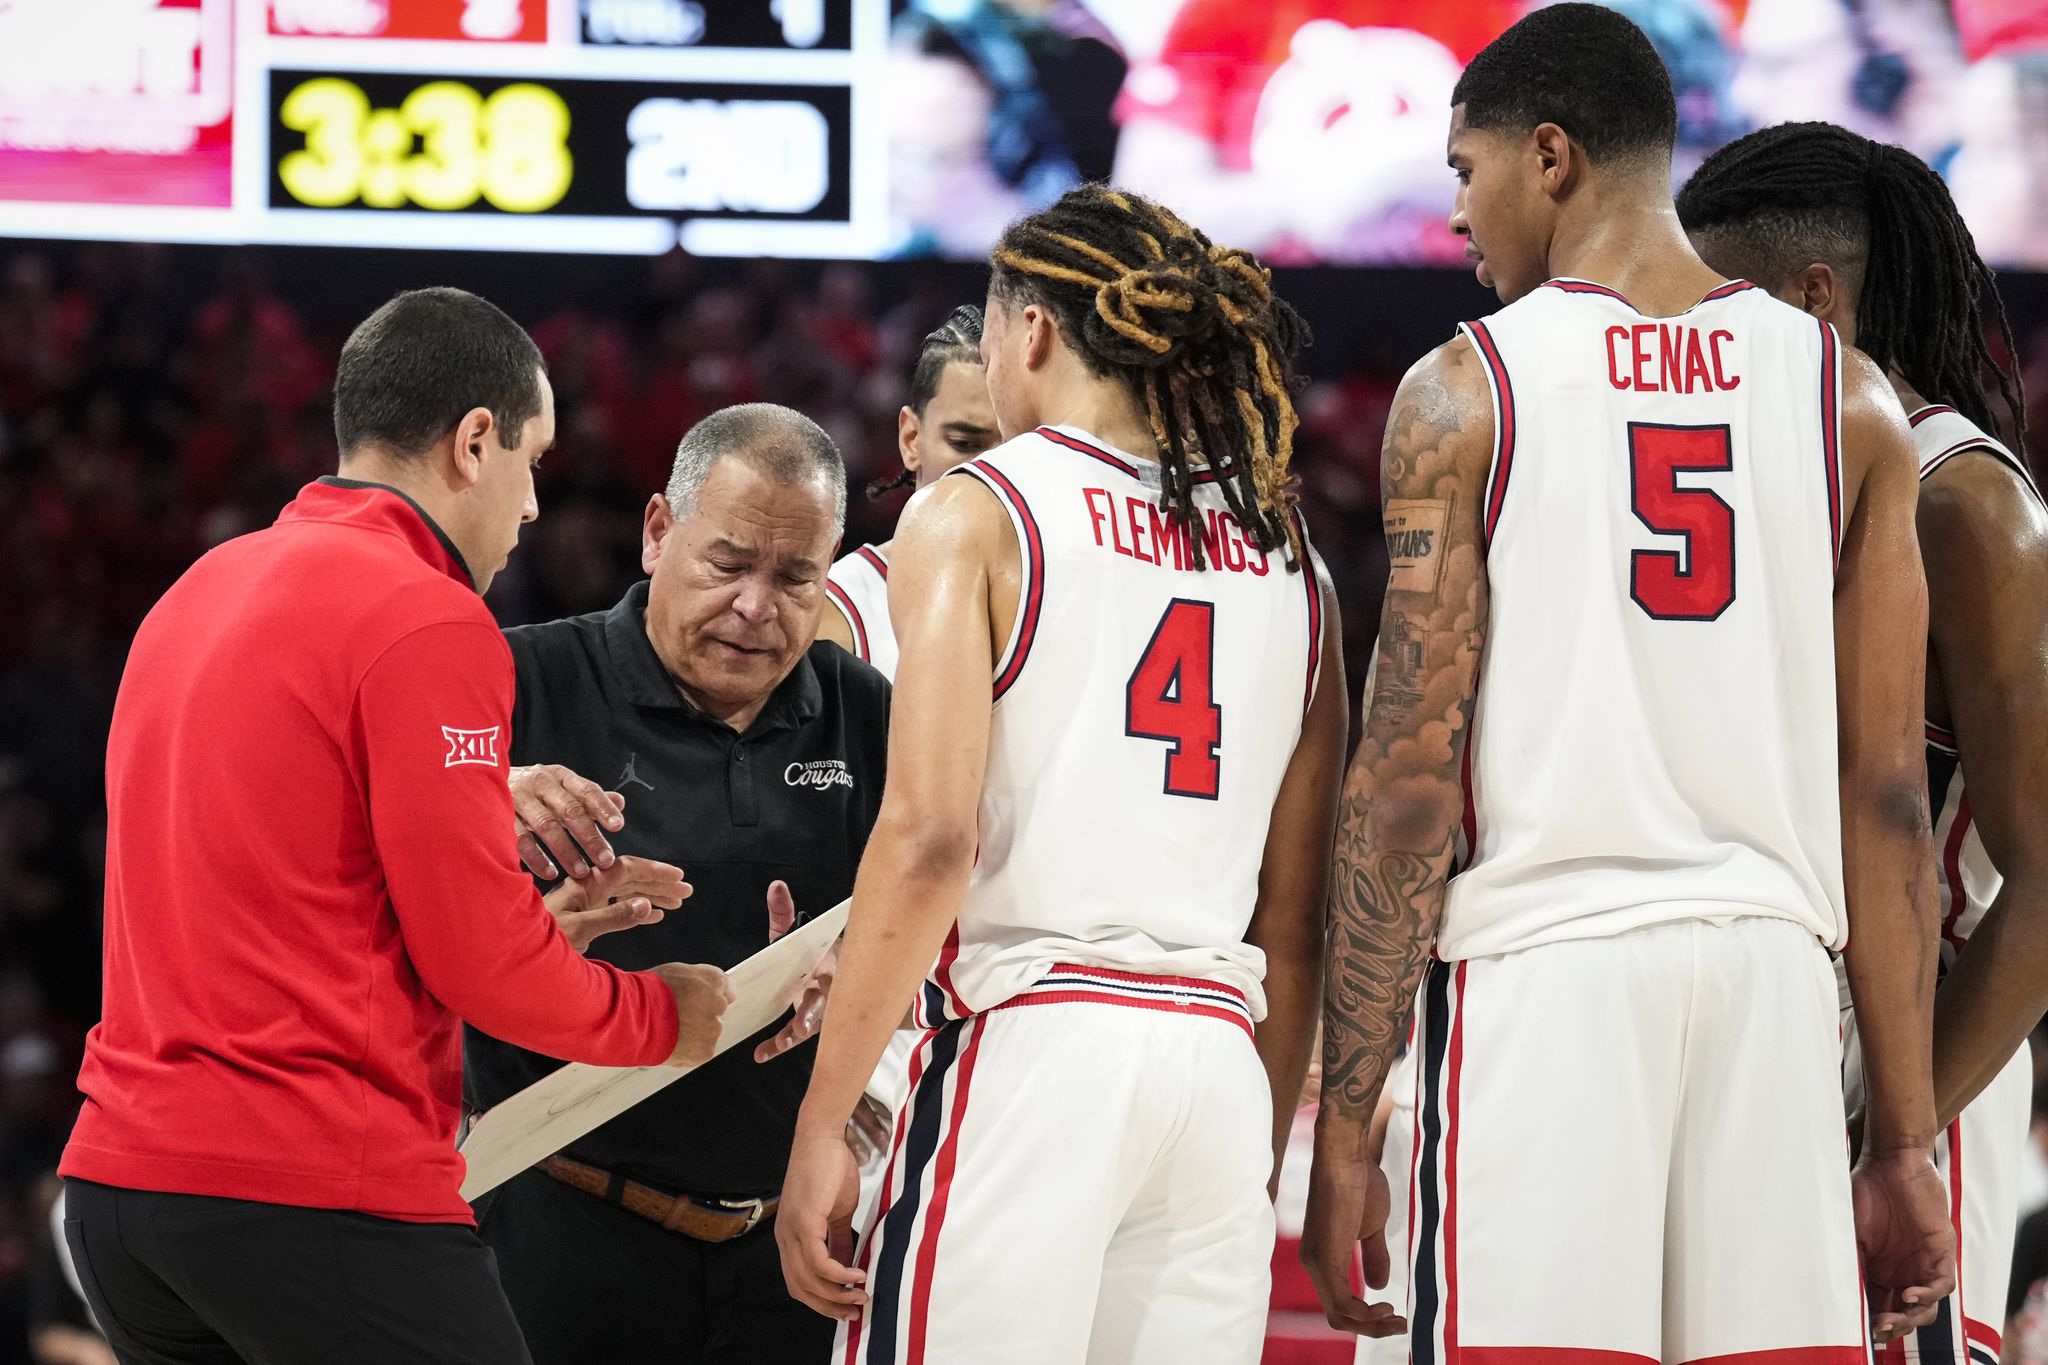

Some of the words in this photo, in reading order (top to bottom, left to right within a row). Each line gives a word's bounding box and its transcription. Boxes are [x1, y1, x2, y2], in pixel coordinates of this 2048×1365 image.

[279, 77, 574, 213] 3:38
[1605, 324, 1740, 394] CENAC
[1083, 487, 1269, 577] FLEMINGS
[1627, 421, 1736, 622] 5
[1125, 597, 1221, 801] 4
[441, 725, 500, 768] XII
[783, 762, 854, 791] Cougars
